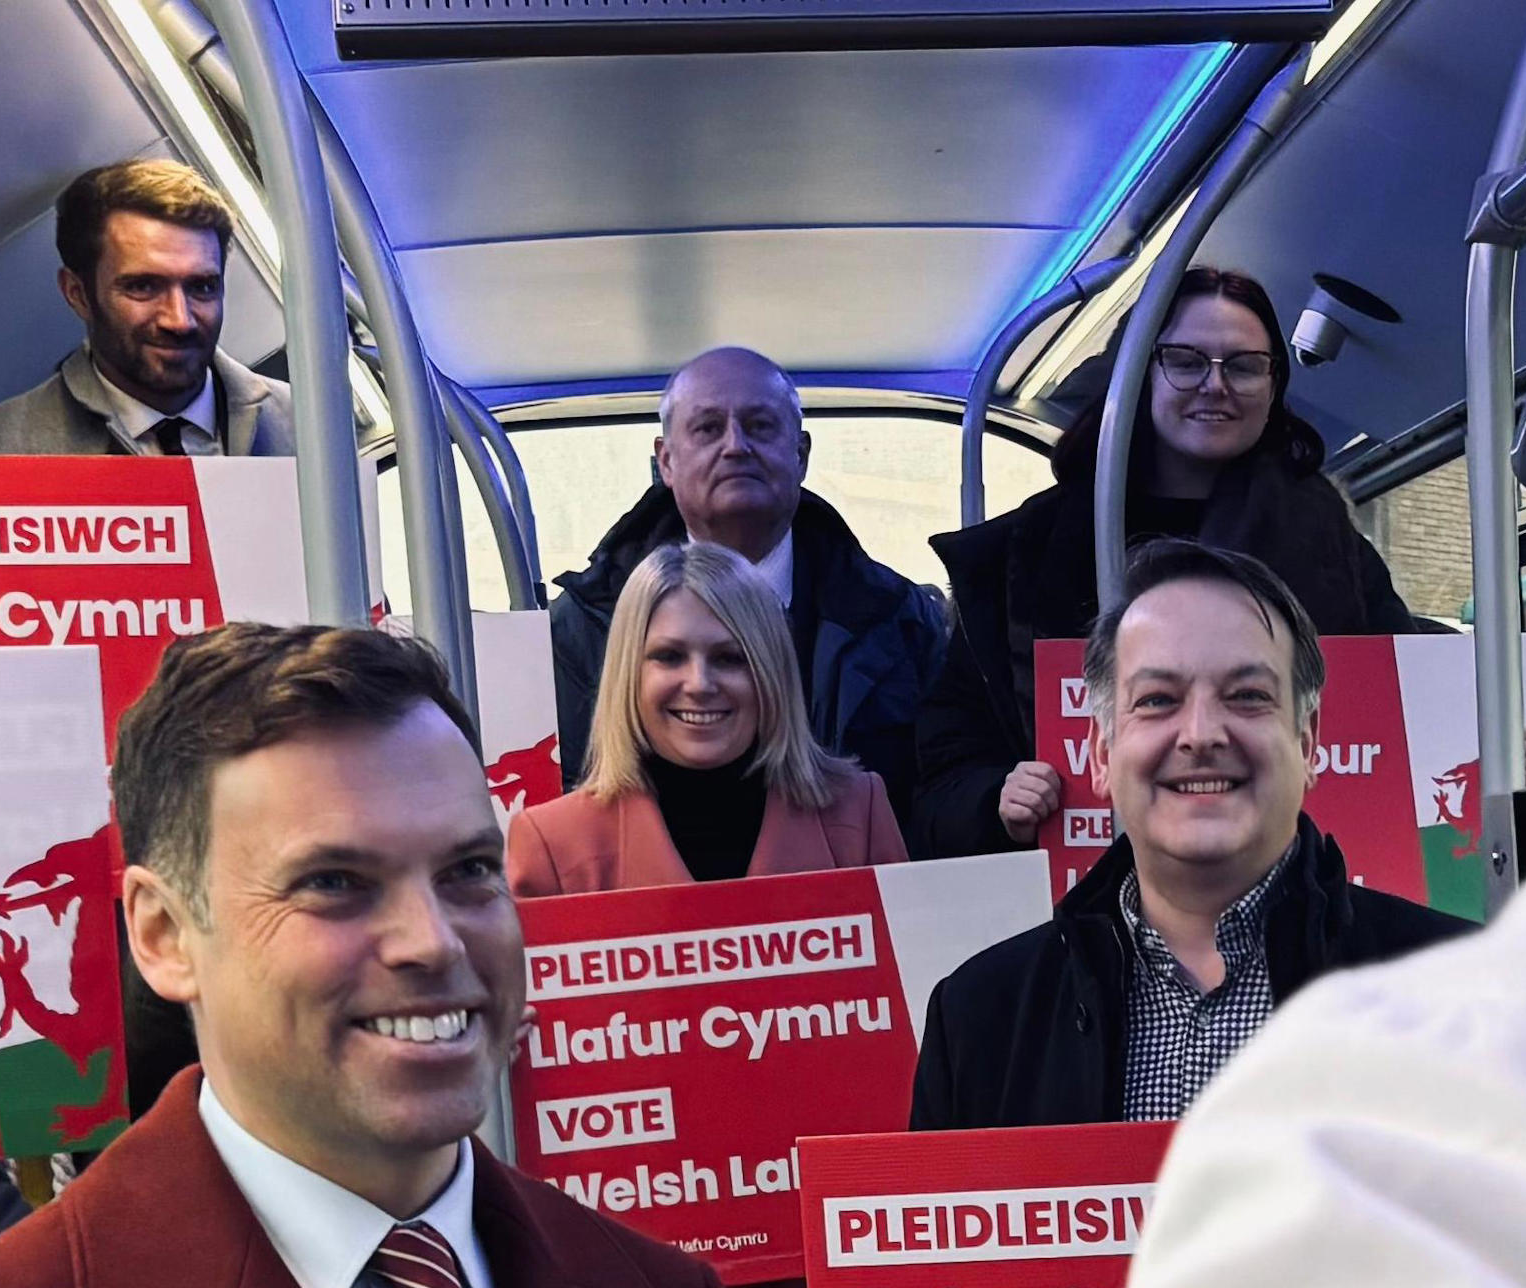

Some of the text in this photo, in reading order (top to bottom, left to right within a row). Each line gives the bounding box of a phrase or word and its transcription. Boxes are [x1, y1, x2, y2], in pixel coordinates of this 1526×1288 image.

[531, 925, 862, 990] PLEIDLEISIWCH
[529, 997, 891, 1068] Llafur Cymru
[546, 1099, 664, 1142] VOTE
[546, 1160, 718, 1211] Welsh
[717, 1233, 767, 1251] Cymru
[839, 1197, 1143, 1253] PLEIDLEISI
